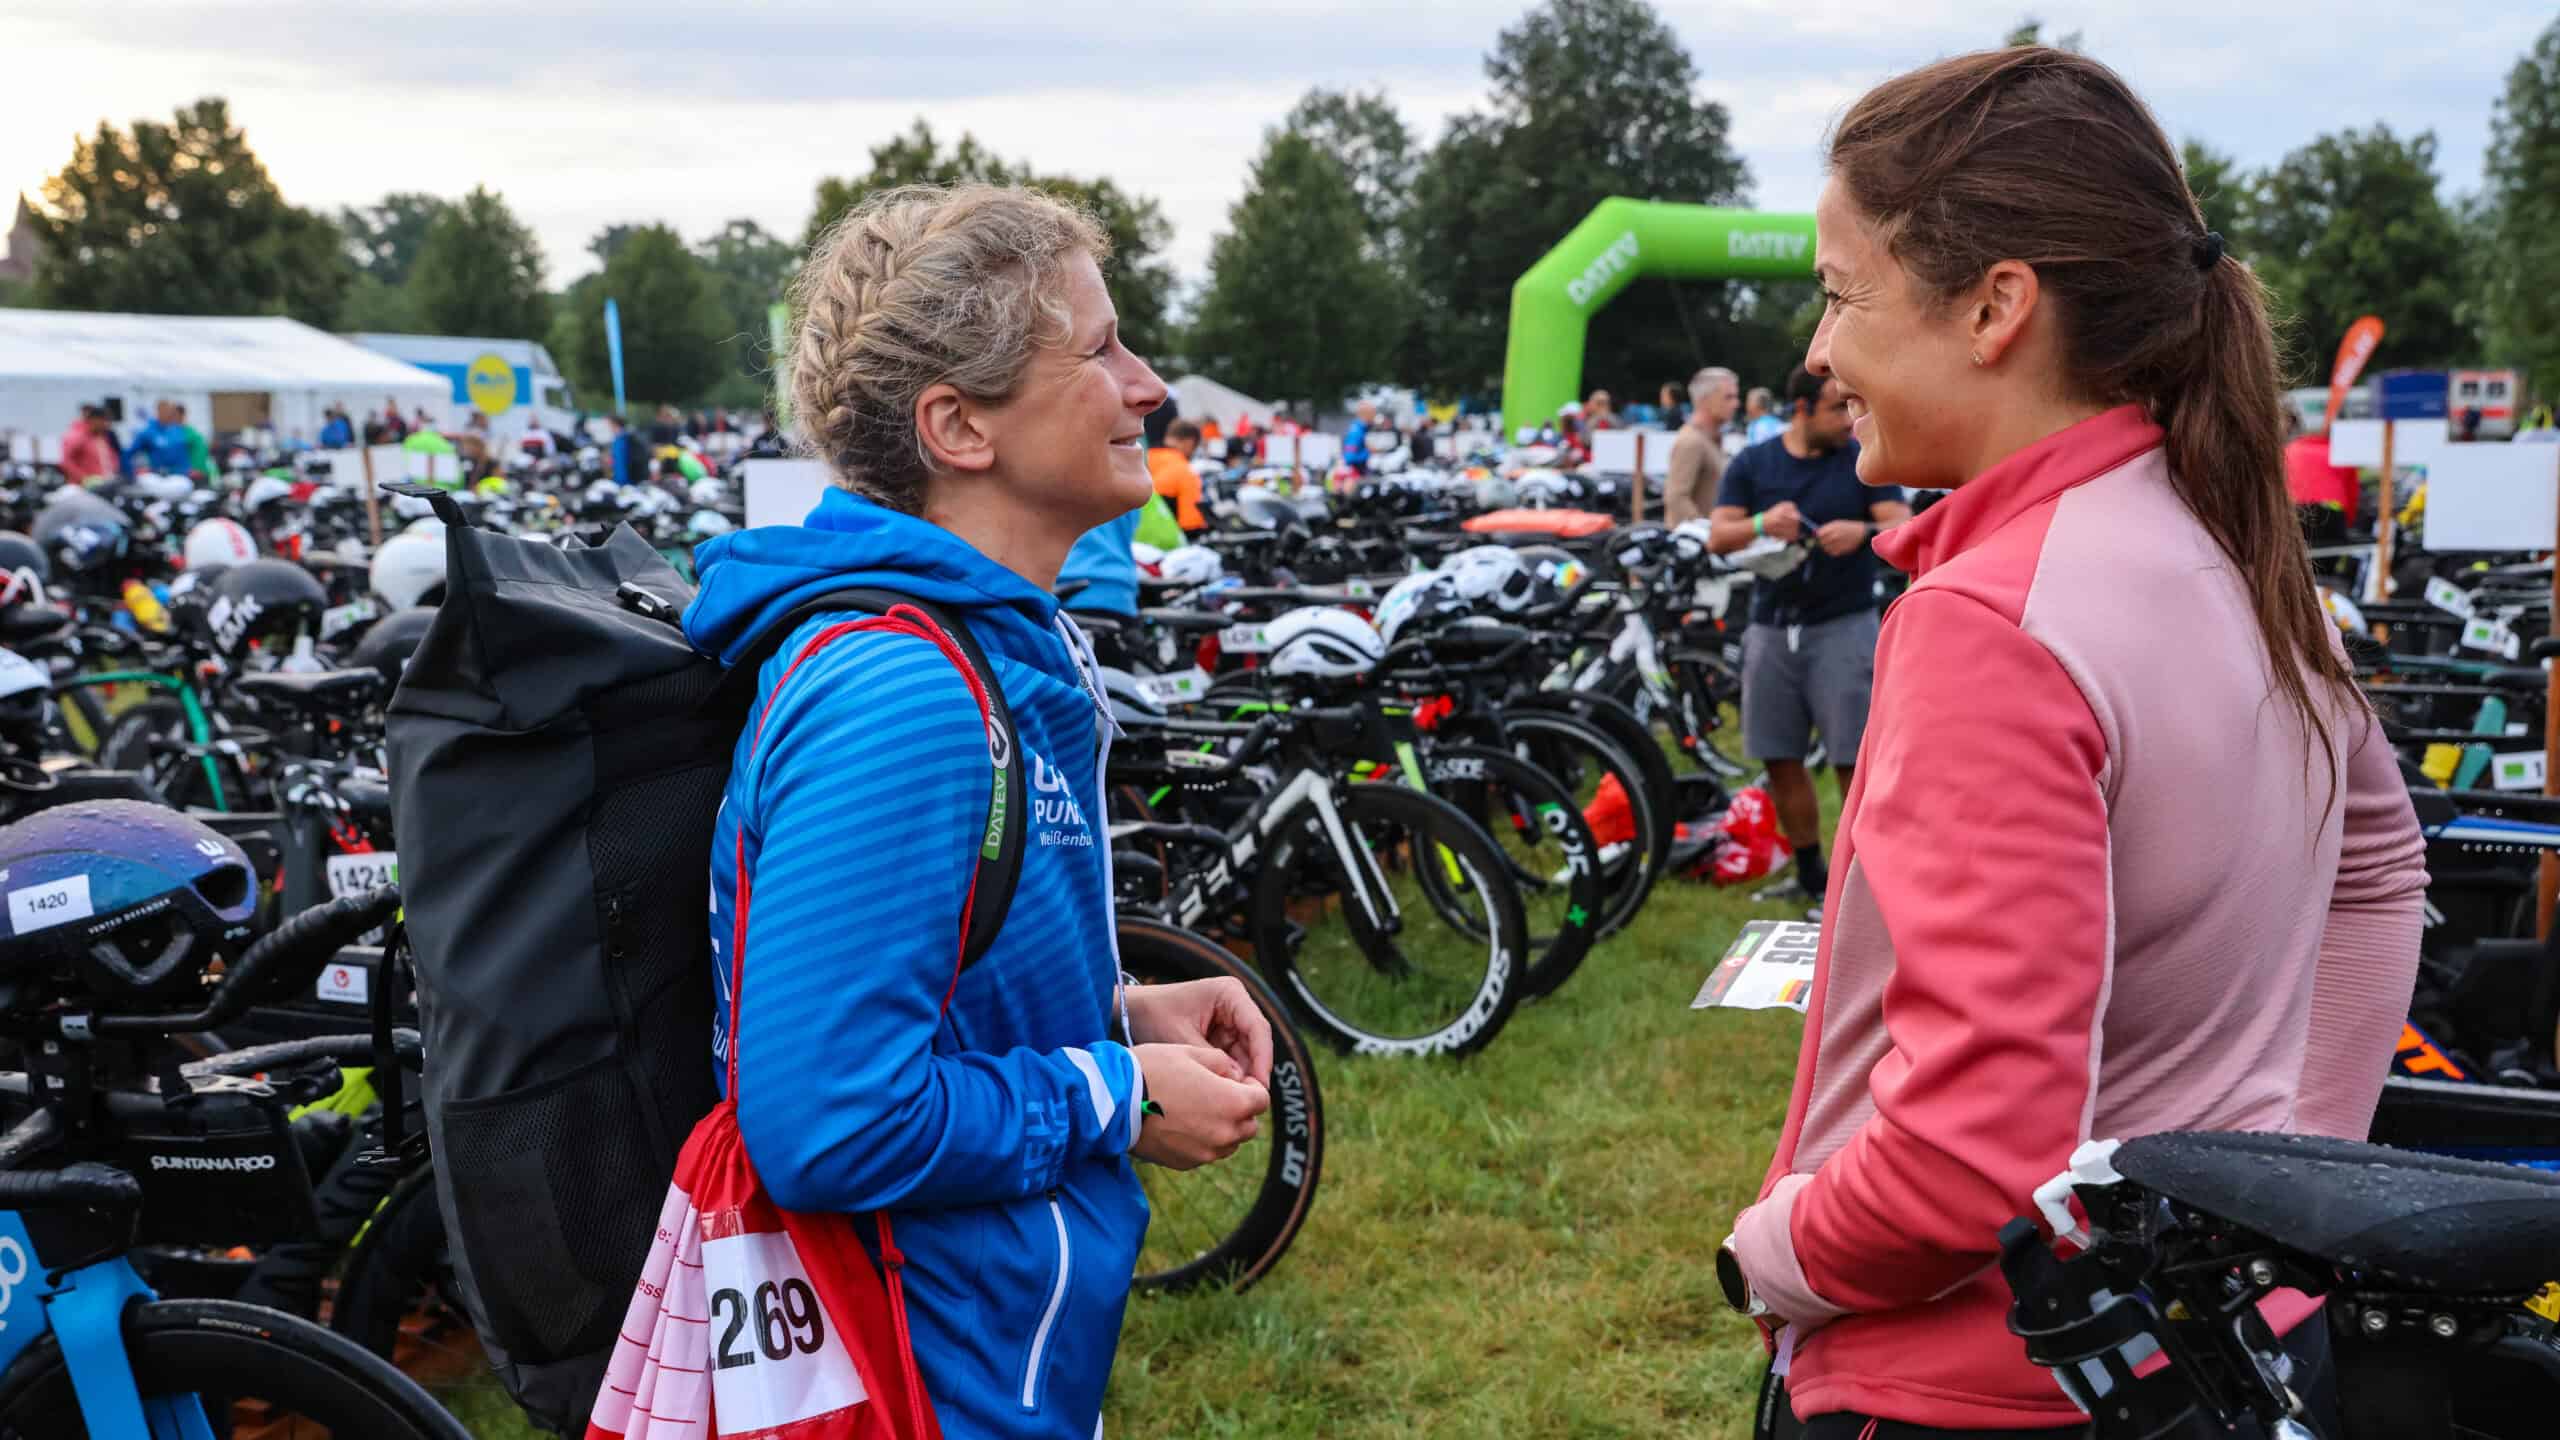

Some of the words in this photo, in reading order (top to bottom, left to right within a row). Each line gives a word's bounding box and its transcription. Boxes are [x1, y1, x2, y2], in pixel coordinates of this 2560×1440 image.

[1728, 231, 1809, 258] DATEV
[1567, 230, 1638, 305] DATEV
[987, 774, 1007, 849] DATEV
[1040, 829, 1094, 849] Weißenbu
[335, 864, 389, 893] 1424
[28, 890, 68, 913] 1420
[1274, 1060, 1309, 1137] SWISS
[150, 1155, 234, 1171] QUINTANA
[234, 1154, 275, 1172] ROO
[1282, 1140, 1306, 1188] DT
[711, 1277, 825, 1371] 269
